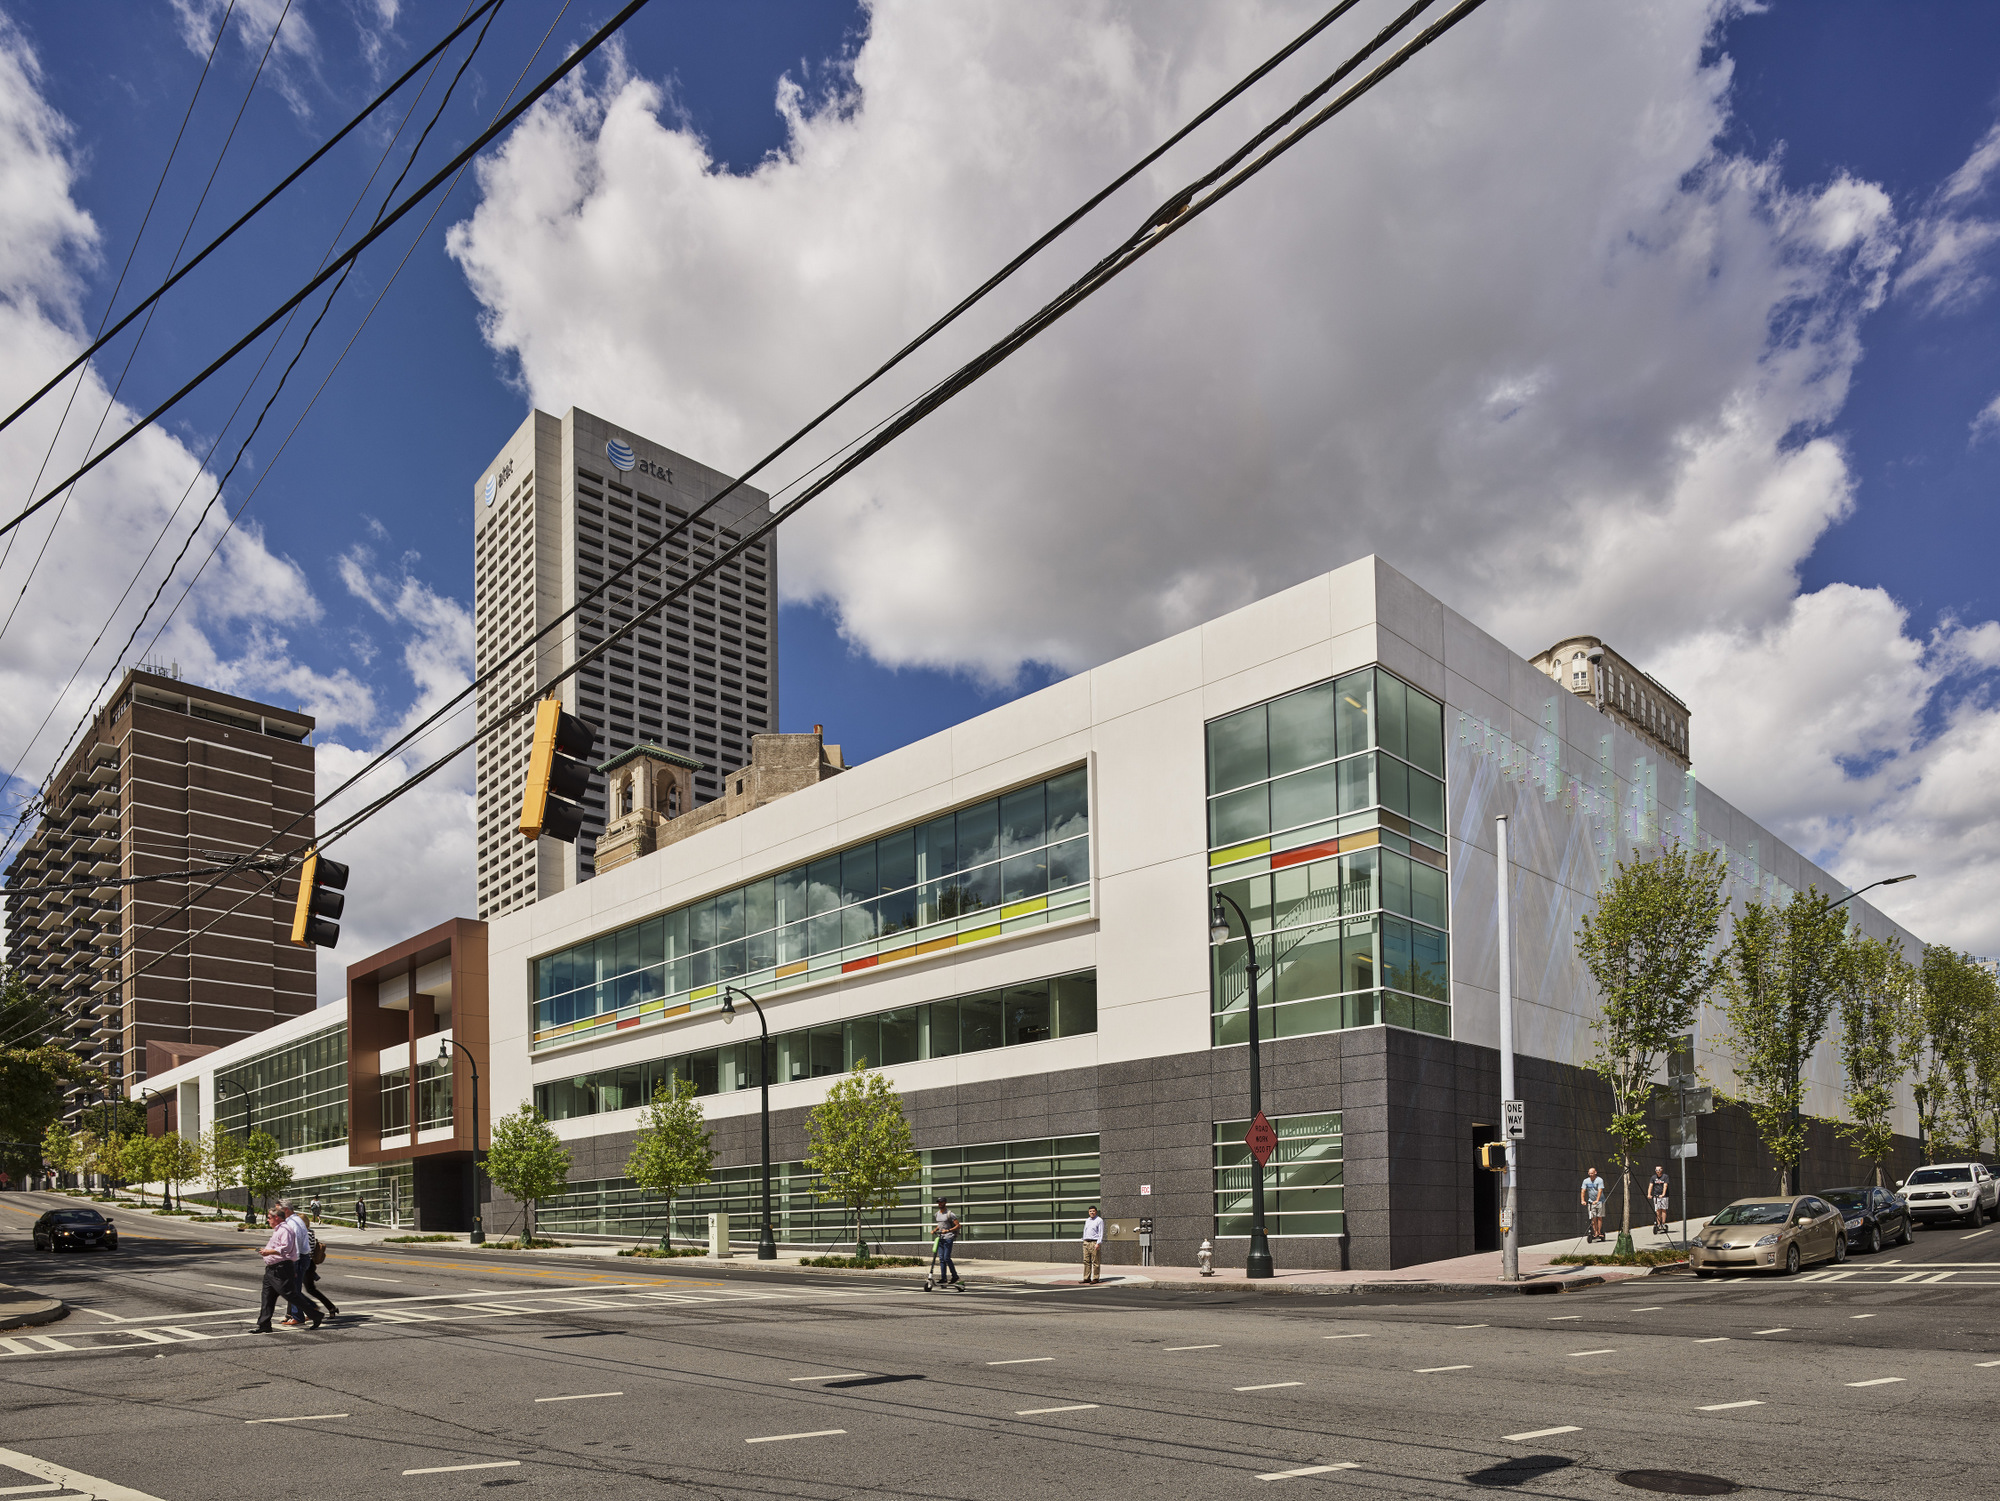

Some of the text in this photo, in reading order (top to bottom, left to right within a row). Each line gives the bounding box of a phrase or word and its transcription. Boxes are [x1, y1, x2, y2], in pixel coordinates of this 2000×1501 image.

[498, 457, 513, 488] at&t
[639, 459, 673, 484] at&t
[1507, 1104, 1522, 1112] ONE
[1508, 1116, 1522, 1124] WAY
[1254, 1145, 1265, 1153] 1500
